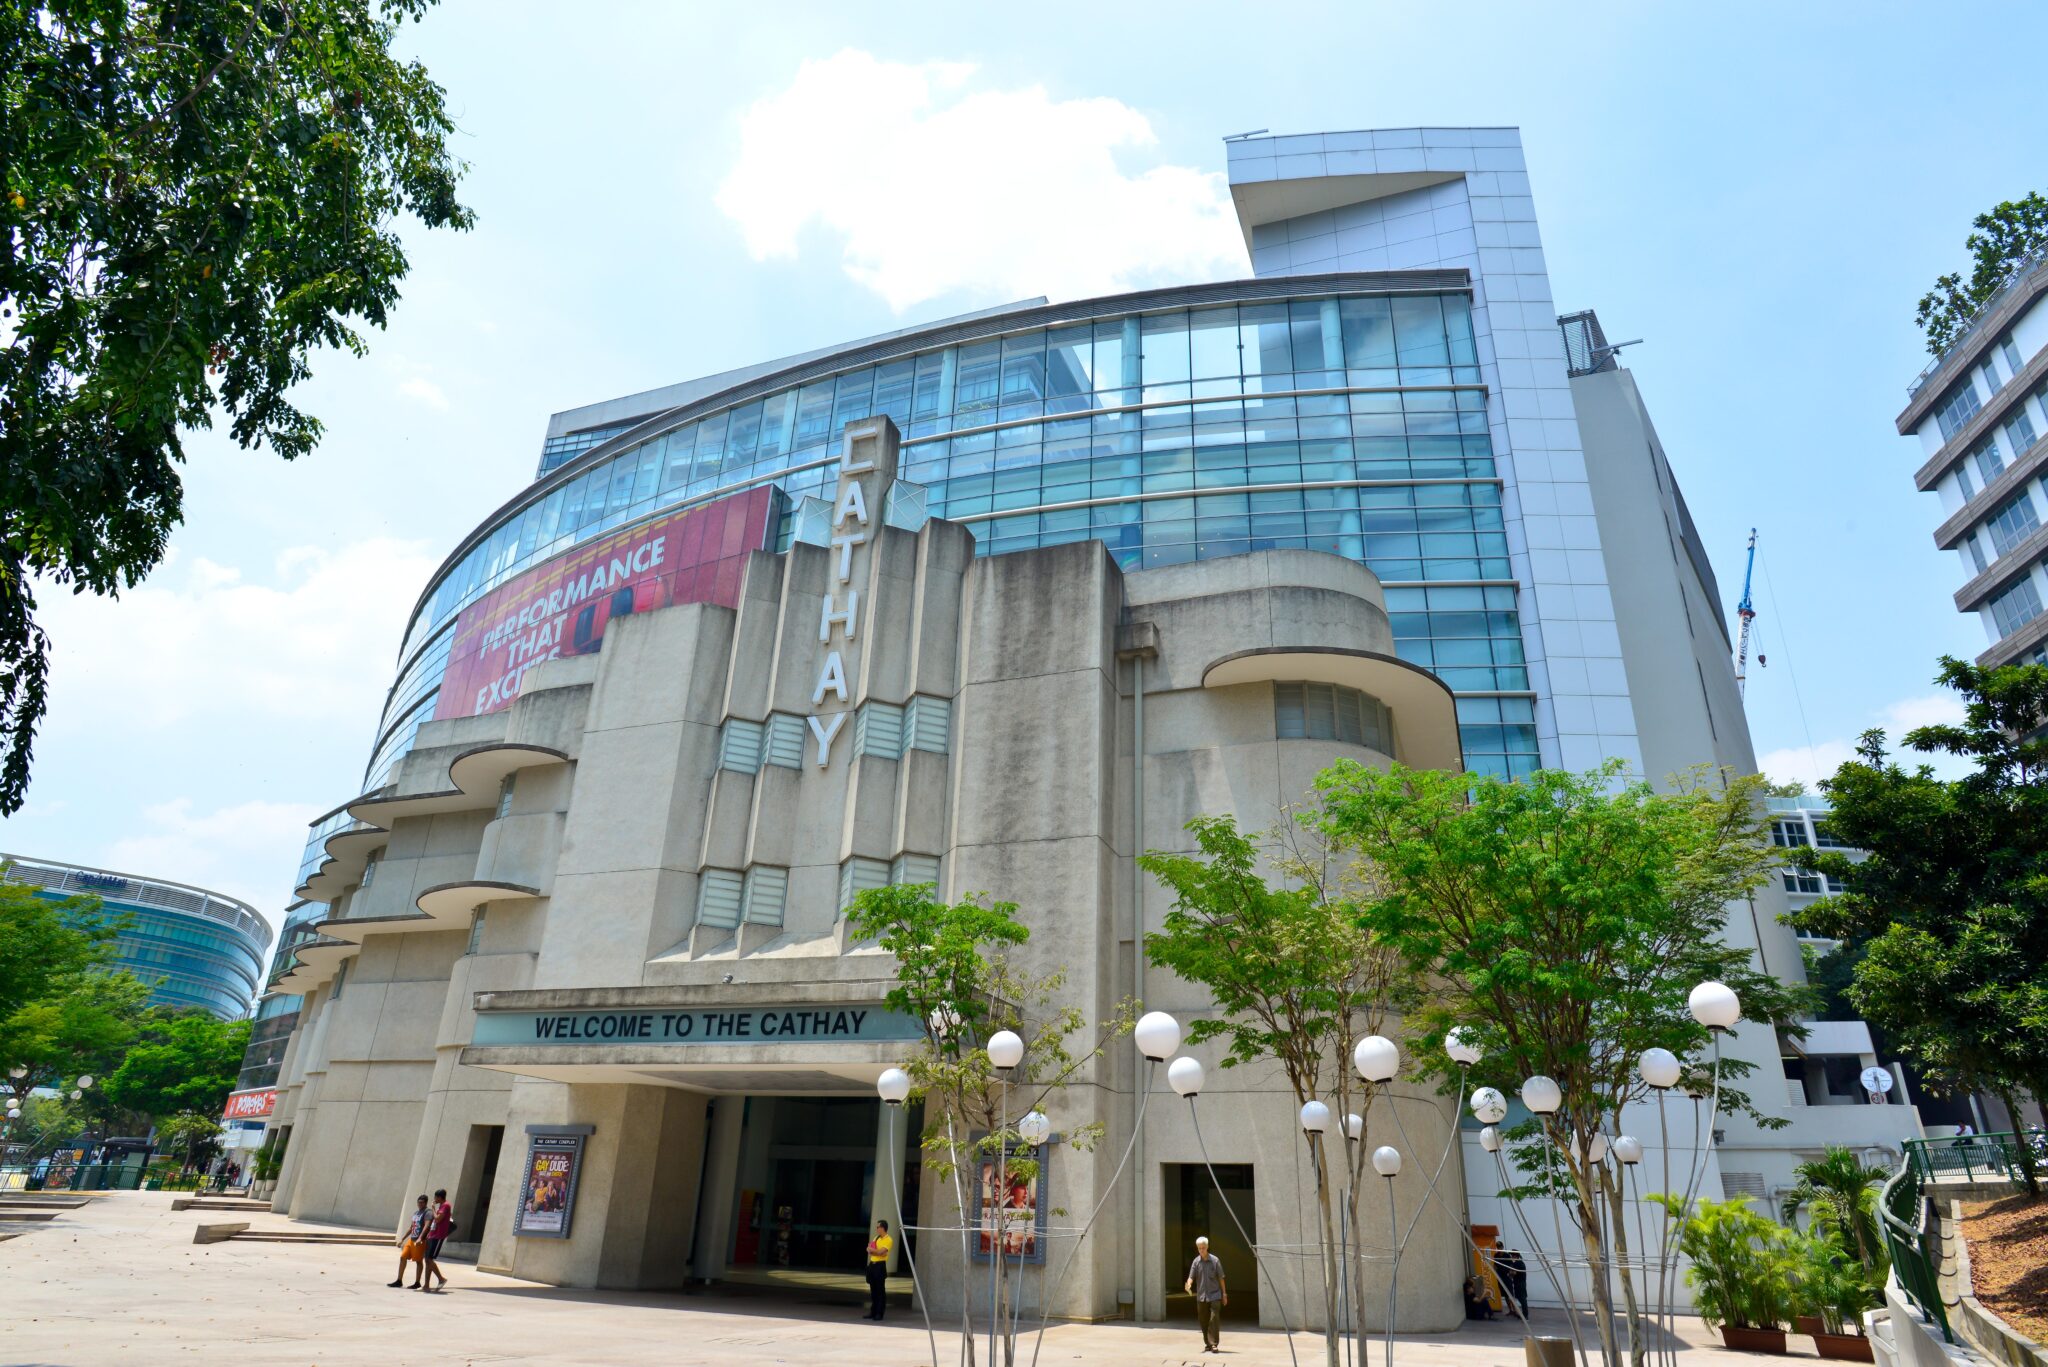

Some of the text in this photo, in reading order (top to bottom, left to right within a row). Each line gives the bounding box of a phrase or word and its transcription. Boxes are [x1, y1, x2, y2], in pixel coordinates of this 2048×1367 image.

[480, 536, 665, 660] PERFORMANCE
[807, 426, 878, 768] CATHAY
[508, 613, 567, 669] THAT
[475, 646, 560, 715] EXCI
[535, 1010, 867, 1039] WELCOME TO THE CATHAY
[535, 1159, 549, 1171] GAY
